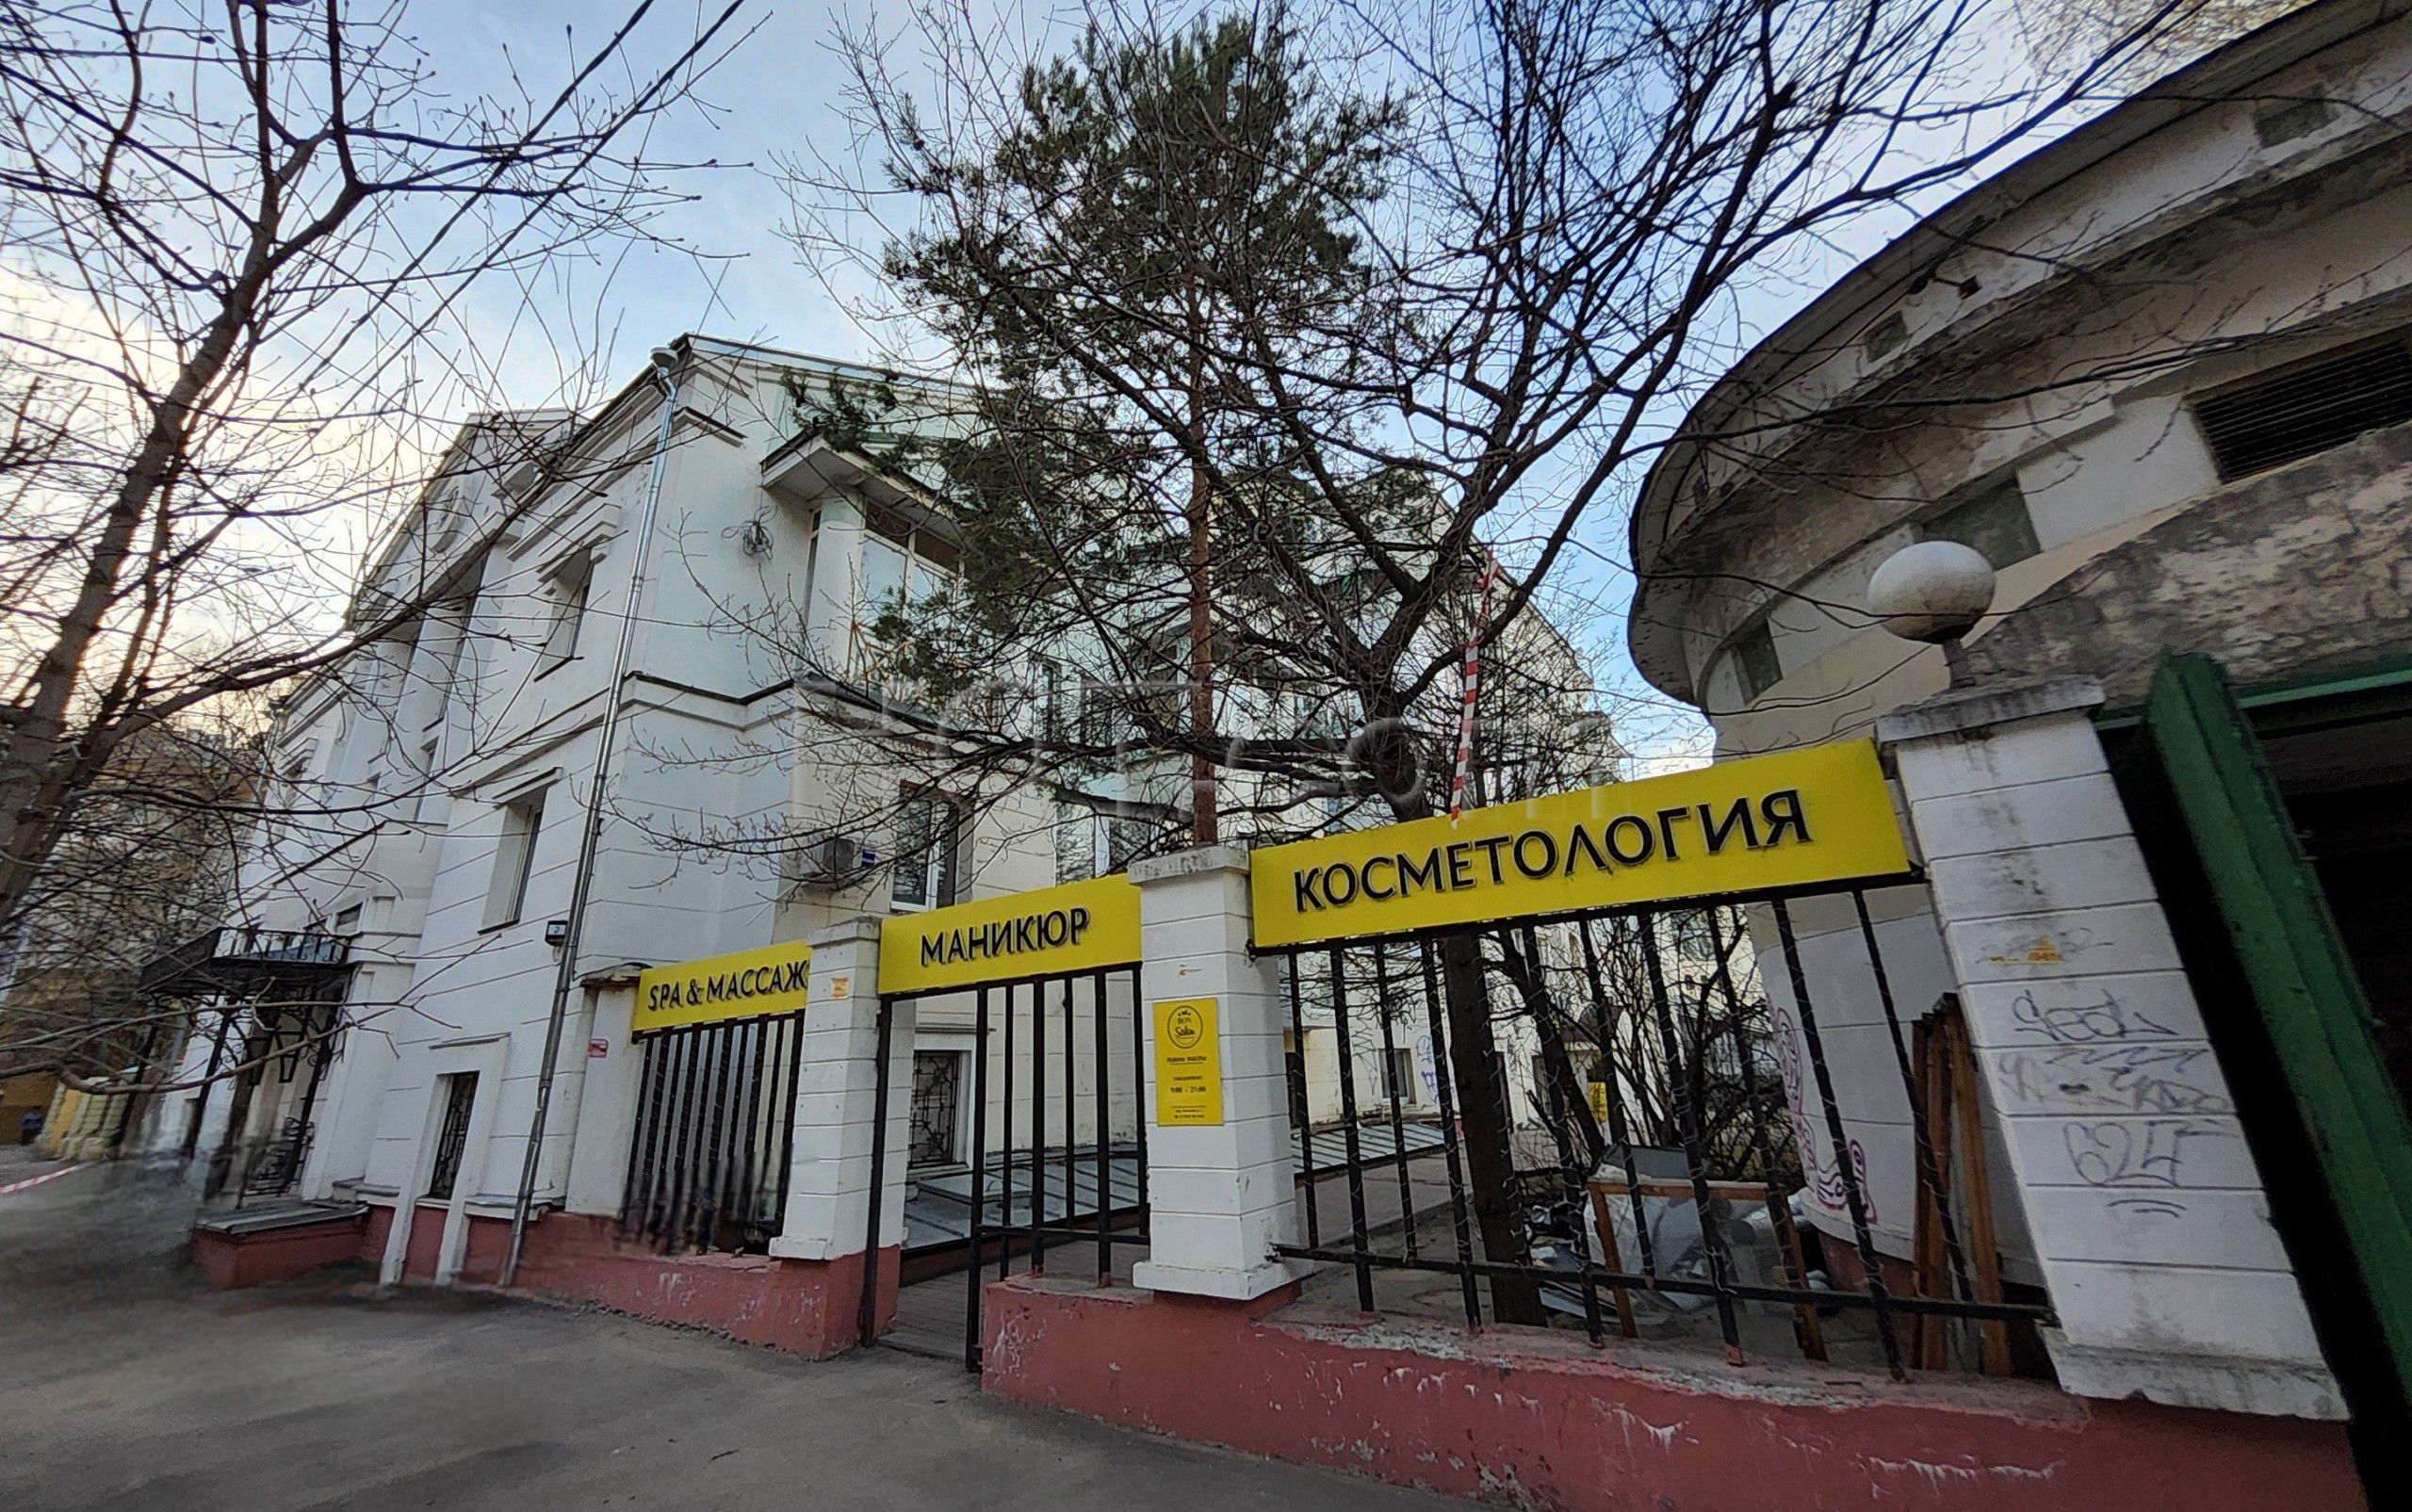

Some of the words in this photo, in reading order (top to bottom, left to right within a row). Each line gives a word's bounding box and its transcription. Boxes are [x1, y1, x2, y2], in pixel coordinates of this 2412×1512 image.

[1294, 789, 1812, 913] КОСМЕТОЛОГИЯ
[921, 907, 1090, 967] МАНИКЮР
[648, 981, 684, 1011] SPA
[686, 978, 704, 1005] &
[706, 960, 807, 1002] МАССАЖ
